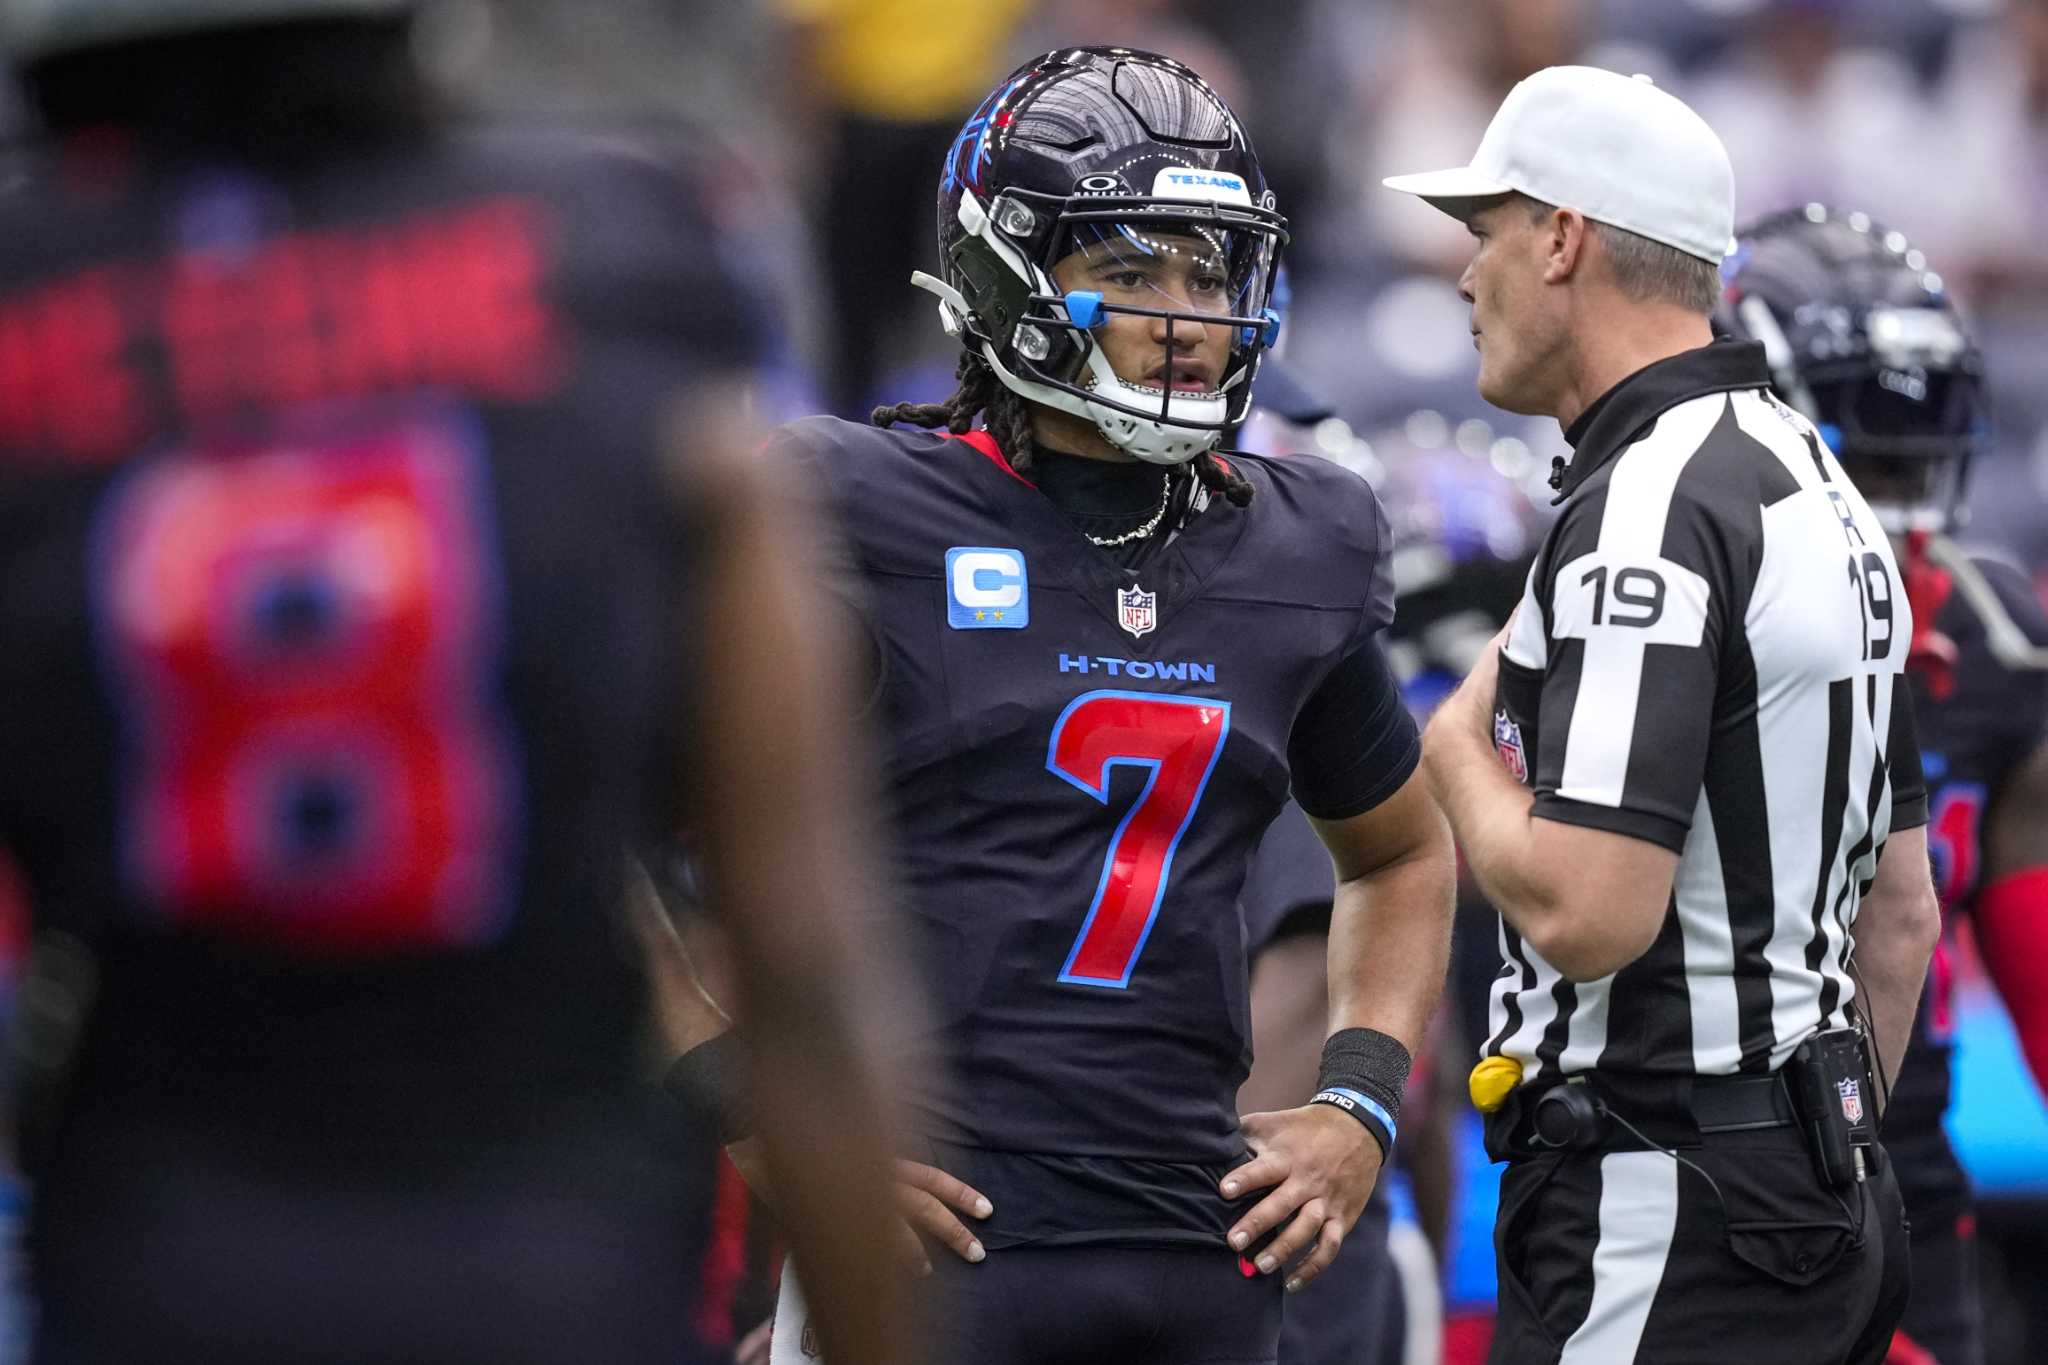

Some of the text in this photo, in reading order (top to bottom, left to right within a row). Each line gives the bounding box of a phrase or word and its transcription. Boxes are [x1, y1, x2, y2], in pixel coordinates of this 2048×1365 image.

[1168, 174, 1242, 191] TEXANS
[953, 552, 1023, 608] C
[1580, 565, 1666, 628] 19
[1848, 552, 1893, 661] 19
[1126, 607, 1150, 628] NFL
[1059, 654, 1216, 683] H-TOWN
[1045, 689, 1231, 989] 7
